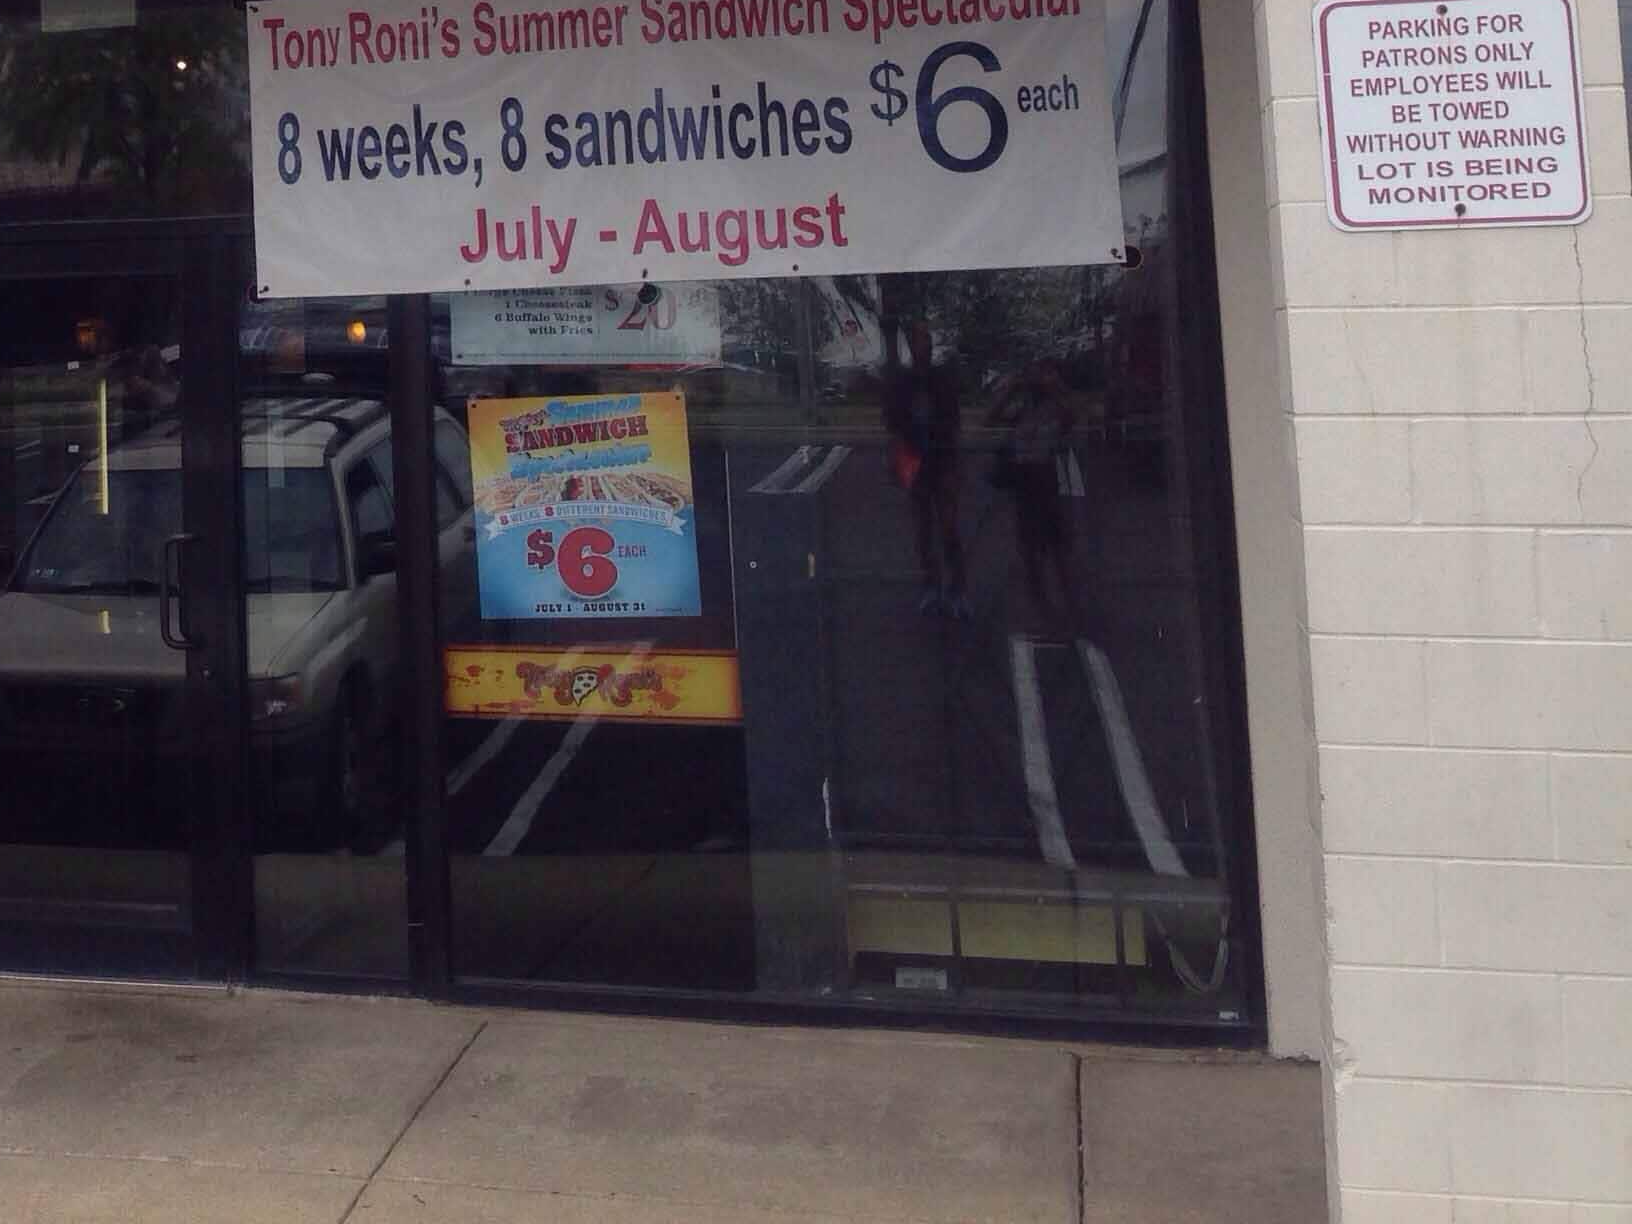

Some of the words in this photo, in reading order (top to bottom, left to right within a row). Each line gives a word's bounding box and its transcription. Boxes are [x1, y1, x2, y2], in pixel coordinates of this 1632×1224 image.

[263, 17, 341, 71] Tony
[347, 6, 460, 66] Roni's
[473, 1, 629, 57] Summer
[1368, 16, 1470, 41] PARKING
[1476, 14, 1524, 34] FOR
[1362, 45, 1467, 68] PATRONS
[1474, 41, 1534, 63] ONLY
[1350, 73, 1489, 97] EMPLOYEES
[1495, 70, 1552, 90] WILL
[1391, 104, 1422, 124] BE
[1428, 100, 1510, 122] TOWED
[277, 111, 303, 185] 8
[316, 103, 483, 188] weeks,
[499, 96, 528, 172] 8
[544, 81, 853, 170] sandwiches
[1017, 74, 1079, 113] each
[1347, 131, 1450, 154] WITHOUT
[1458, 126, 1566, 149] WARNING
[1357, 161, 1417, 181] LOT
[1427, 160, 1454, 178] IS
[1465, 156, 1559, 177] BEING
[1368, 182, 1552, 205] MONITORED
[460, 205, 577, 275] July
[632, 193, 848, 266] August
[506, 312, 550, 322] Buffalo
[554, 312, 593, 324] Wings
[528, 325, 557, 335] with
[561, 325, 593, 335] Fries
[505, 415, 649, 454] SANDWICH
[618, 545, 648, 558] EACH
[535, 603, 562, 613] JULY
[583, 603, 629, 612] AUGUST
